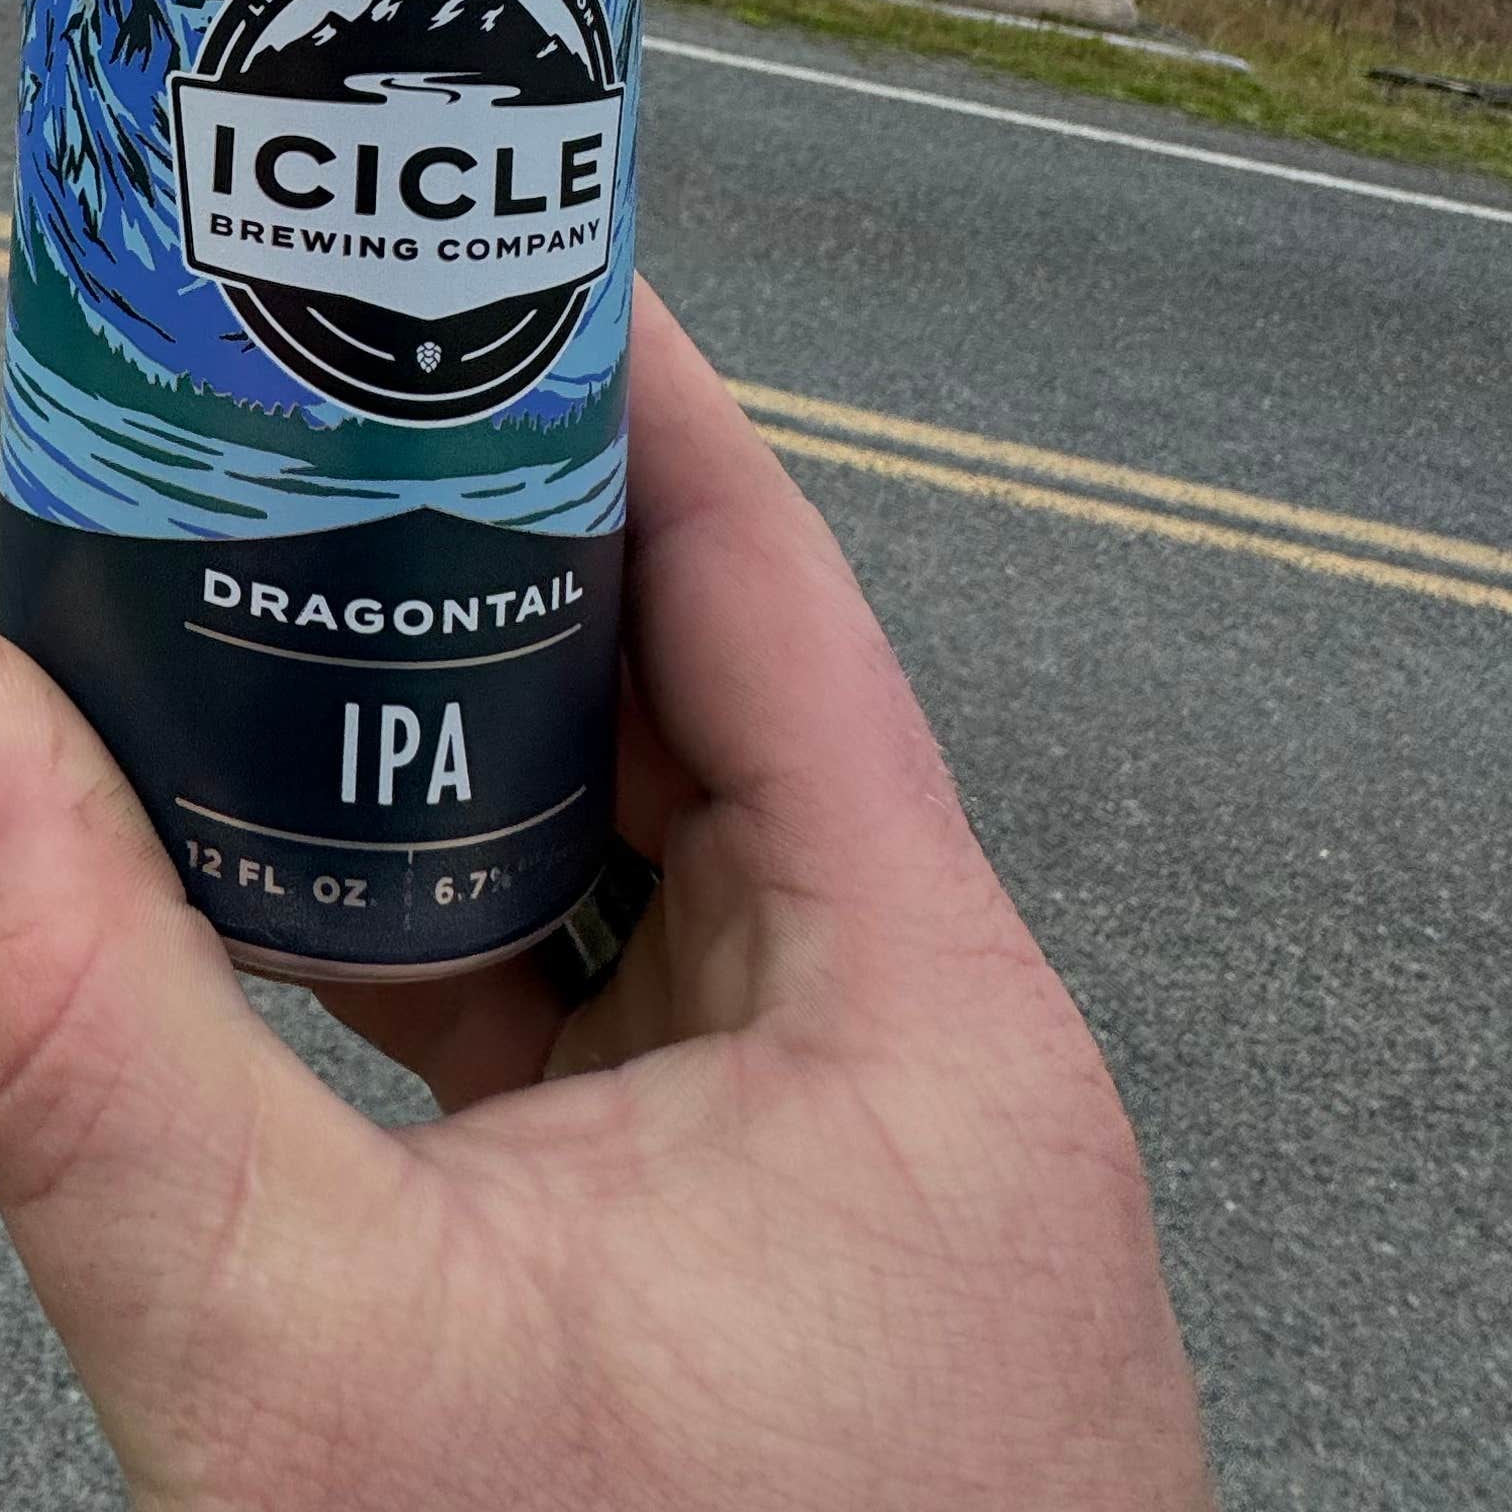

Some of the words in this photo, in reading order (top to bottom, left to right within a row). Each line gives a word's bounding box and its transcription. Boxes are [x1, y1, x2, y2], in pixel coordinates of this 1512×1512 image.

[212, 124, 604, 220] ICICLE
[210, 213, 420, 261] BREWING
[437, 218, 601, 261] COMPANY
[202, 567, 584, 636] DRAGONTAIL
[340, 701, 473, 806] IPA
[185, 839, 223, 879] 12
